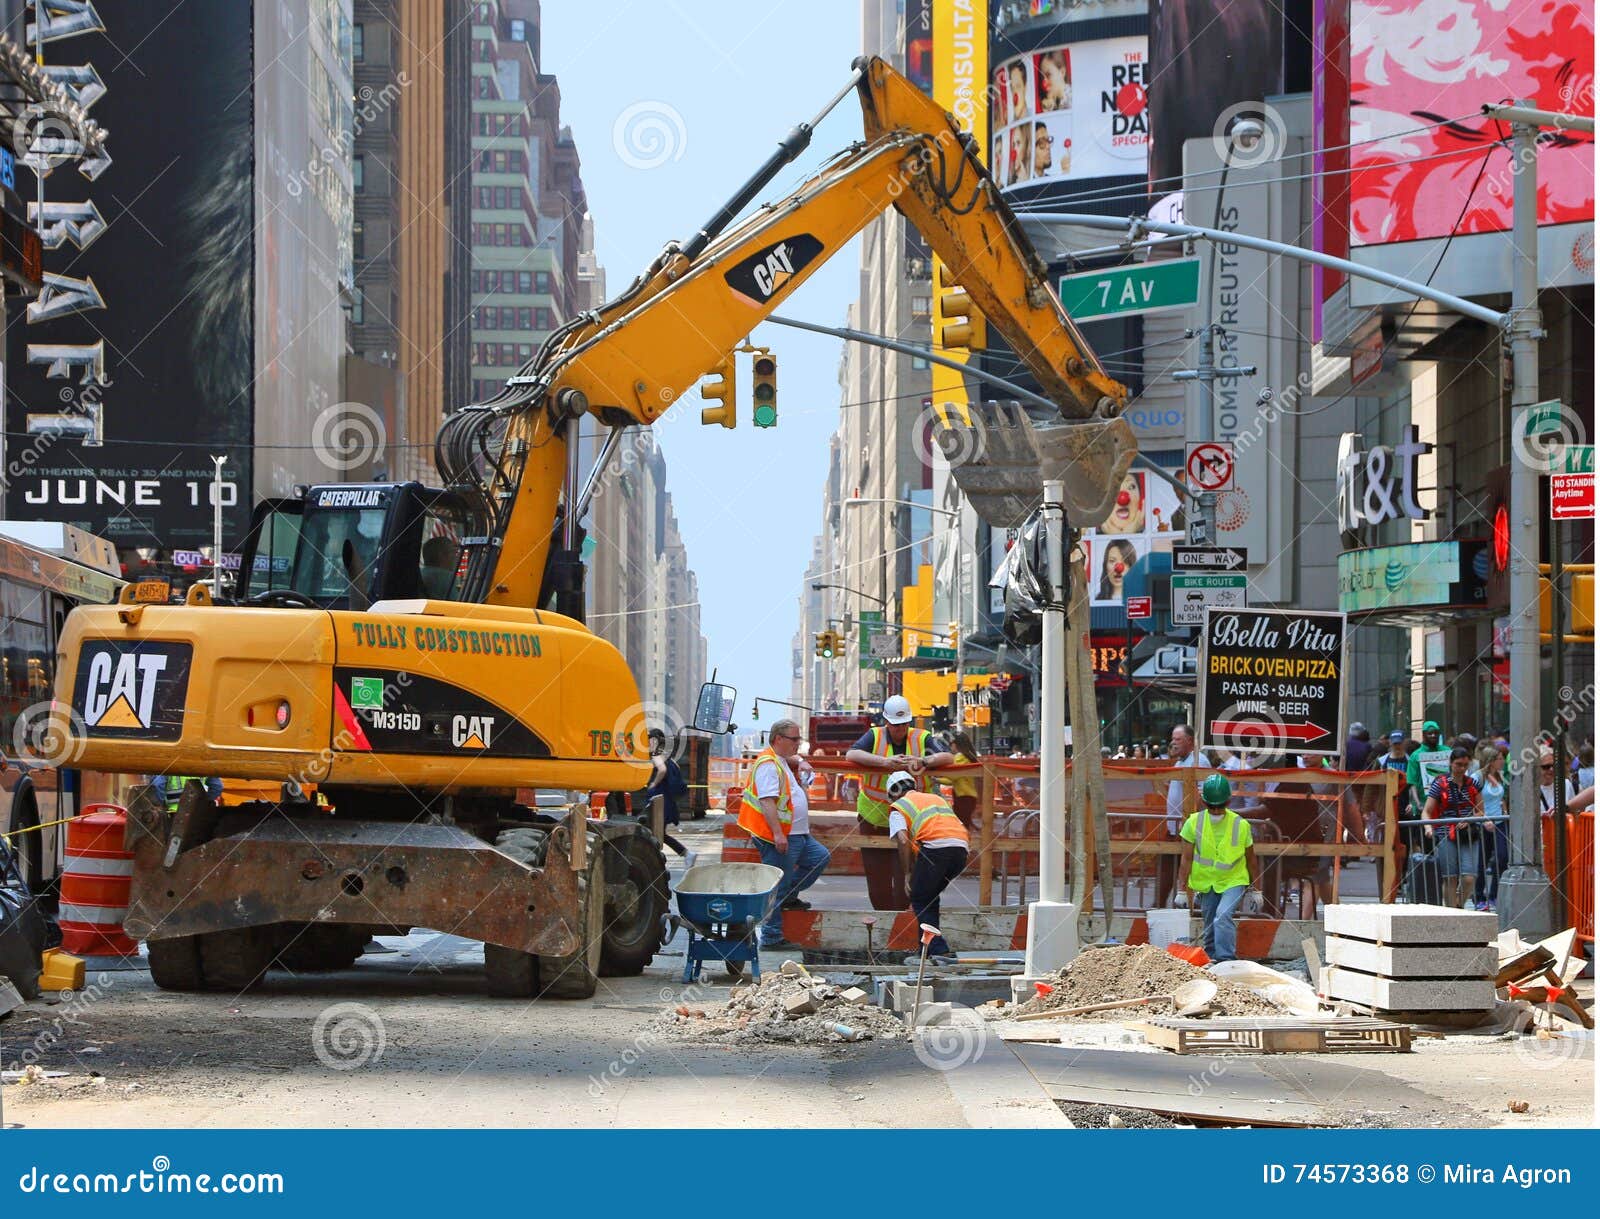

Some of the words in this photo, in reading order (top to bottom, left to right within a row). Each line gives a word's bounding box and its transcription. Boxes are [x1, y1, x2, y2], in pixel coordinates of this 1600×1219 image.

[1124, 52, 1142, 62] THE
[753, 242, 795, 296] CAT
[1220, 206, 1239, 325] REUTERS
[1098, 280, 1112, 308] 7
[1572, 448, 1584, 471] W
[160, 469, 183, 478] AND
[1555, 480, 1565, 489] NO
[25, 479, 161, 506] JUNE
[187, 481, 238, 506] 10
[318, 490, 380, 507] CATERPILLAR
[1555, 488, 1584, 500] Anytime
[1183, 554, 1207, 565] ONE
[1214, 554, 1236, 565] WAY
[1184, 578, 1203, 588] BIKE
[1206, 577, 1234, 587] ROUTE
[352, 621, 408, 650] TULLY
[414, 627, 542, 658] CONSTRUCTION
[1212, 615, 1280, 649] Bella
[1285, 618, 1337, 651] Vita
[1210, 655, 1252, 676] BRICK
[1255, 656, 1295, 677] OVEN
[1296, 658, 1337, 679] PIZZA
[85, 650, 168, 728] CAT
[1222, 682, 1269, 697] PASTAS
[1278, 683, 1325, 698] SALADS
[1236, 700, 1267, 714] WINE
[1279, 702, 1309, 716] BEER
[373, 711, 421, 731] M315D
[452, 714, 495, 749] CAT
[588, 730, 612, 757] TB
